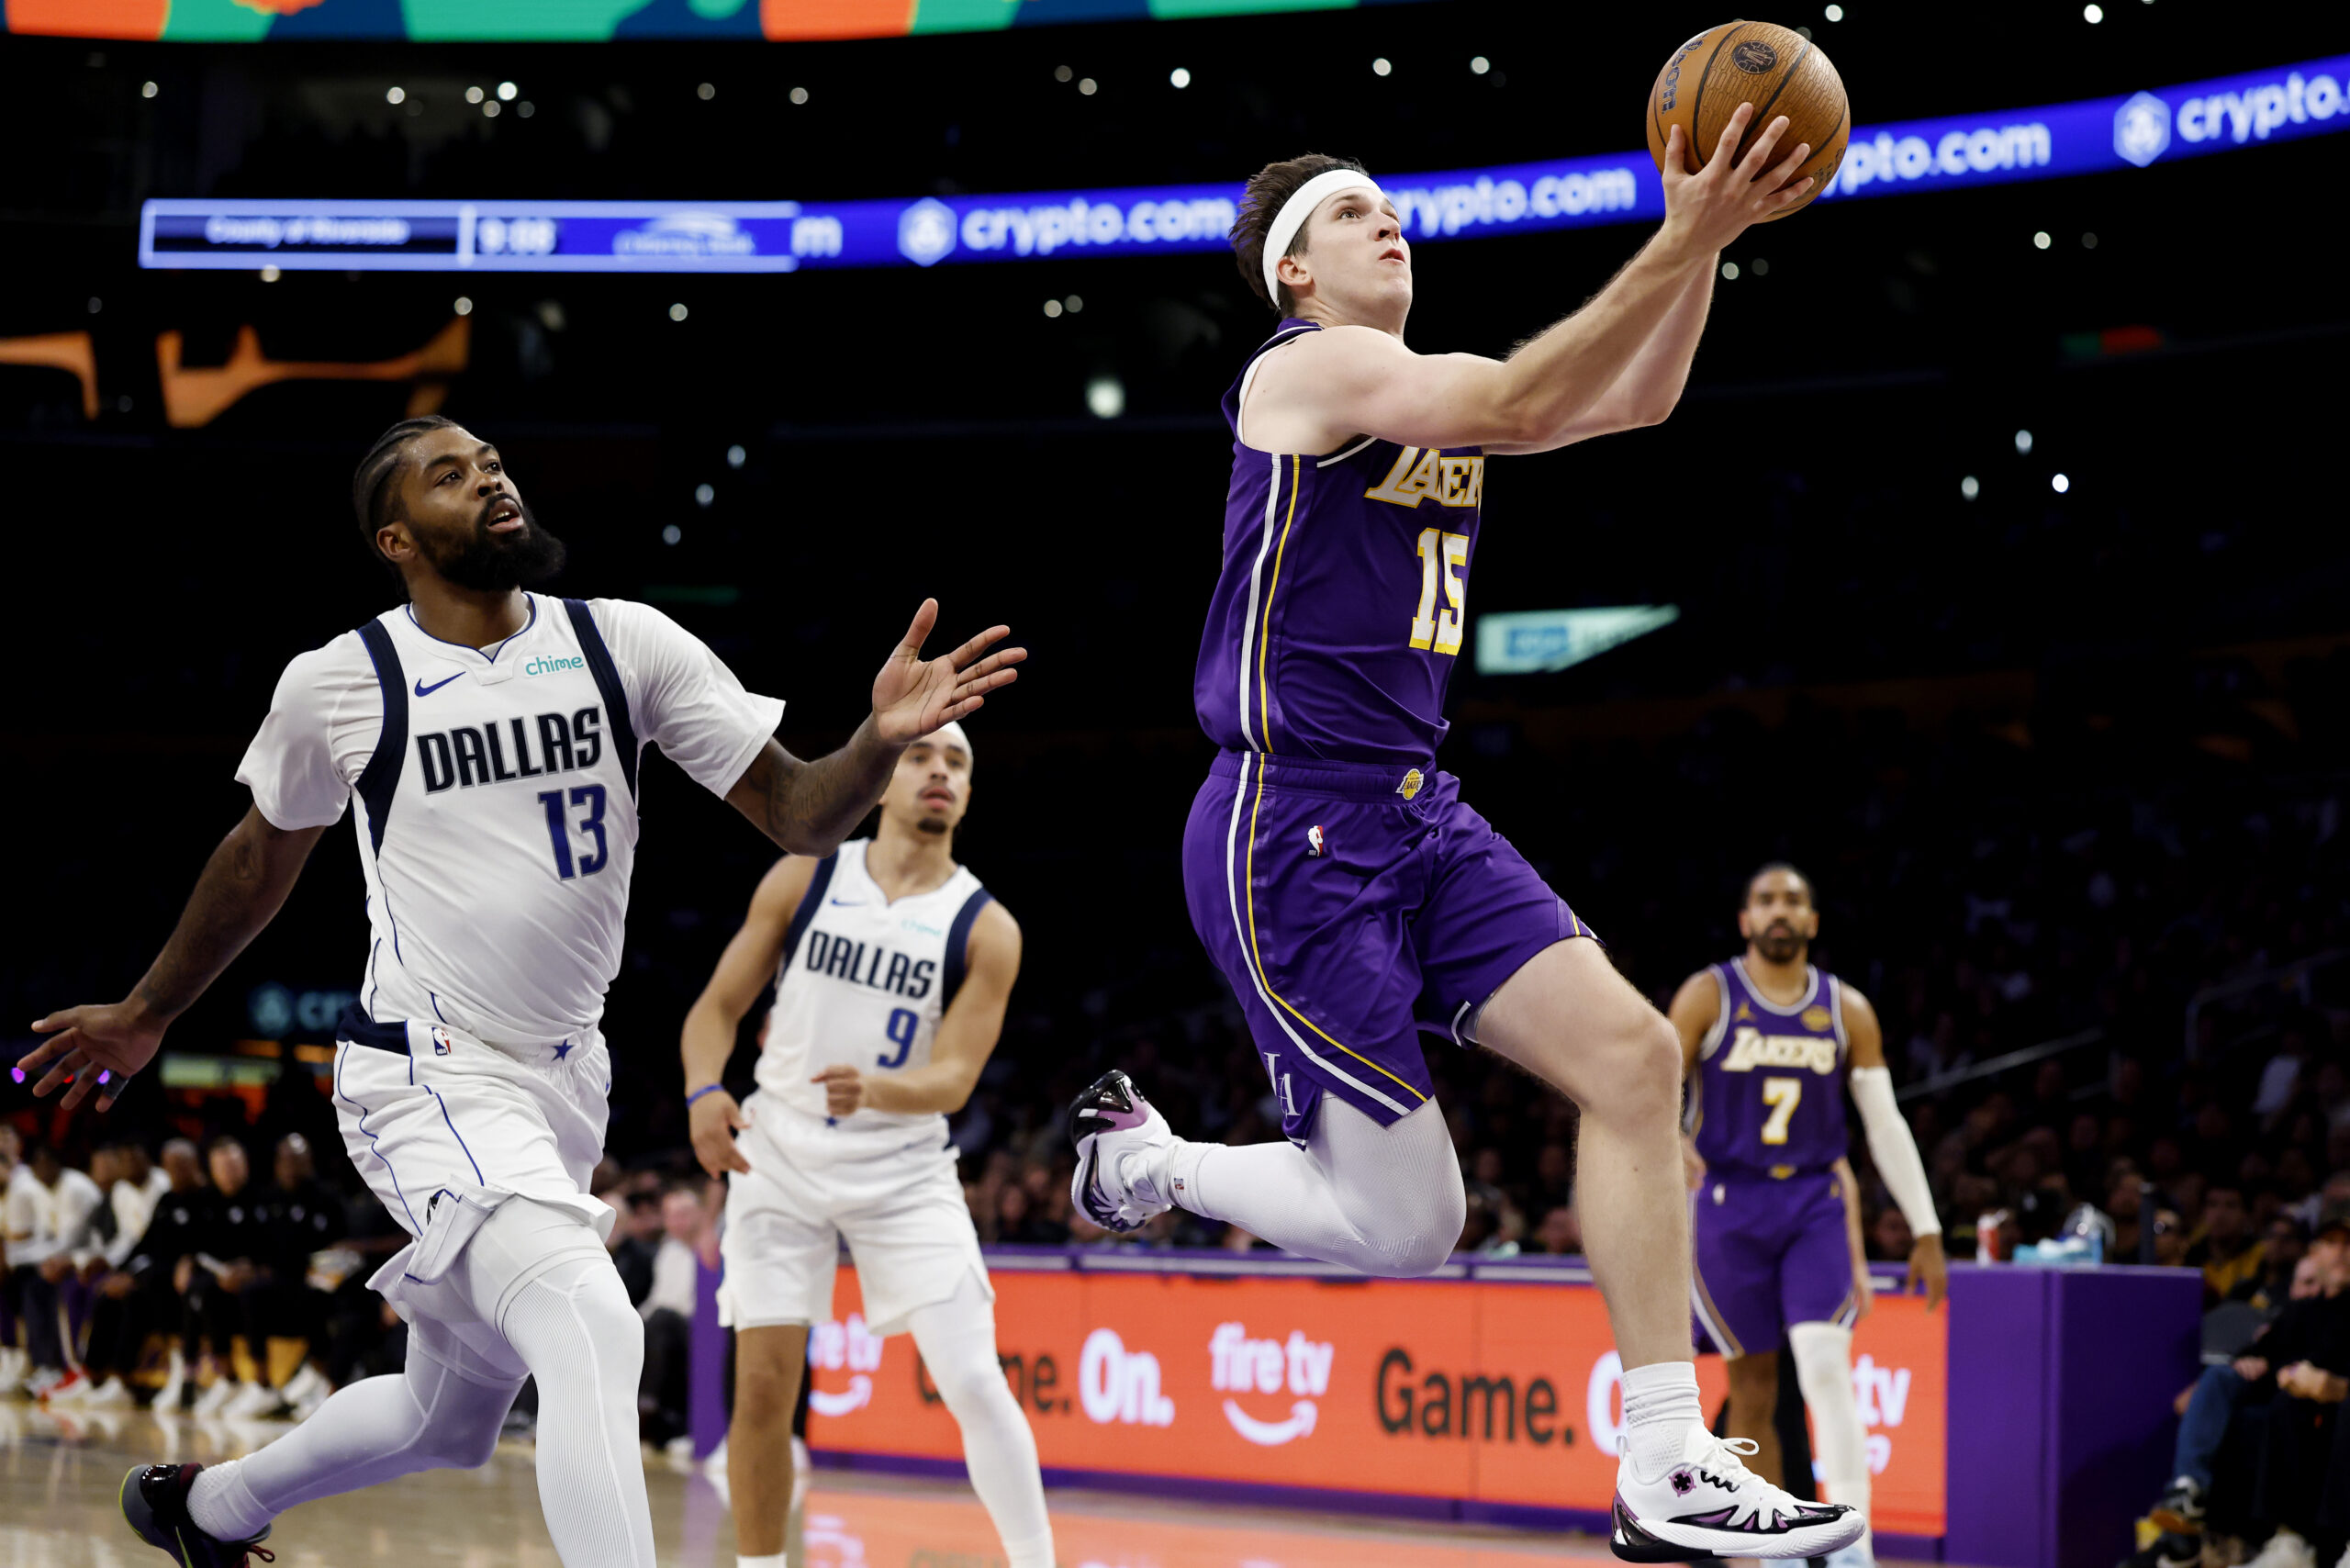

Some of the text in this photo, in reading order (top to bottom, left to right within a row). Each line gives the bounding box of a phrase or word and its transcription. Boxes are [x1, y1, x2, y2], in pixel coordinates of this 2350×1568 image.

[2177, 72, 2350, 144] crypto.
[962, 196, 1234, 256] crypto.com
[1389, 168, 1636, 237] rypto.com
[1409, 527, 1469, 655] 15
[526, 655, 584, 676] chime
[414, 705, 601, 795] DALLAS
[537, 782, 609, 881] 13
[806, 929, 935, 1000] DALLAS
[877, 1008, 919, 1070] 9
[1760, 1076, 1802, 1145] 7
[1079, 1327, 1176, 1428] On.
[1208, 1322, 1335, 1396] fire tv
[1375, 1345, 1576, 1447] Game.
